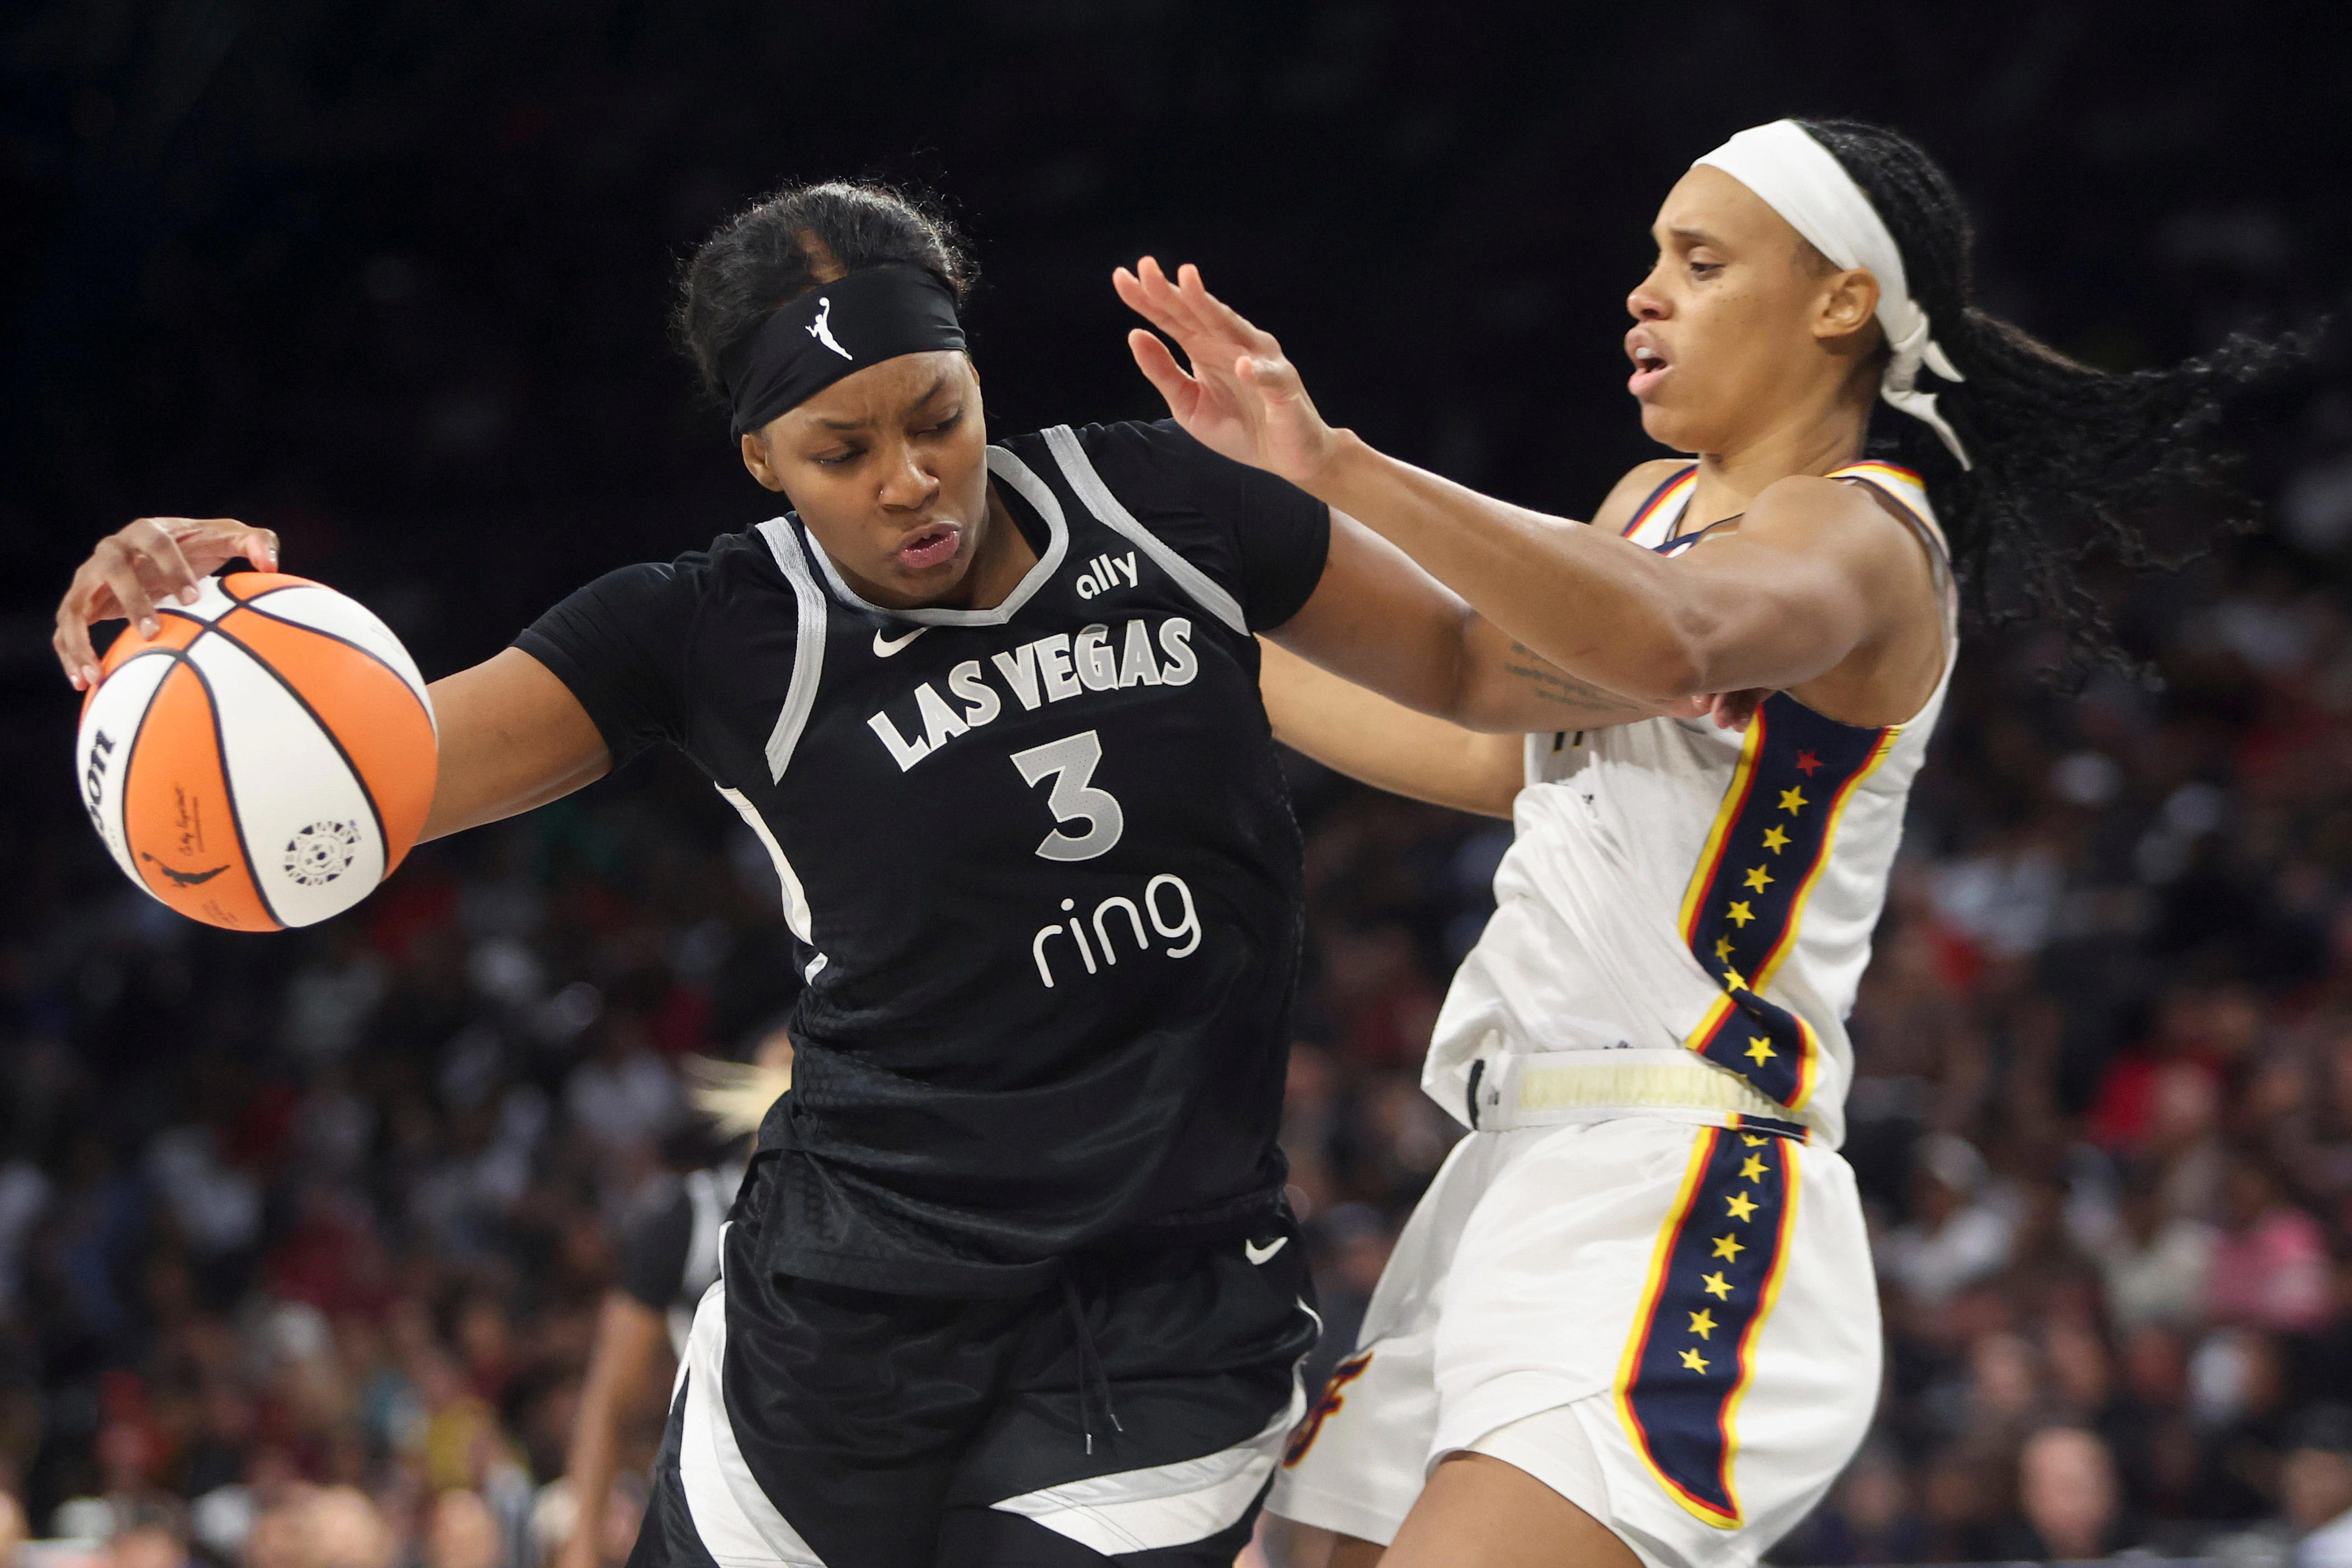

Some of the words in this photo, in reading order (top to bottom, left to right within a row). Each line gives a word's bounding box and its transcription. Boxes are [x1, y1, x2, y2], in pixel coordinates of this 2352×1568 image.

[1076, 551, 1138, 600] ally
[867, 660, 1001, 773] LAS
[991, 617, 1198, 711] VEGAS
[1009, 729, 1124, 861] 3
[1033, 873, 1202, 988] ring
